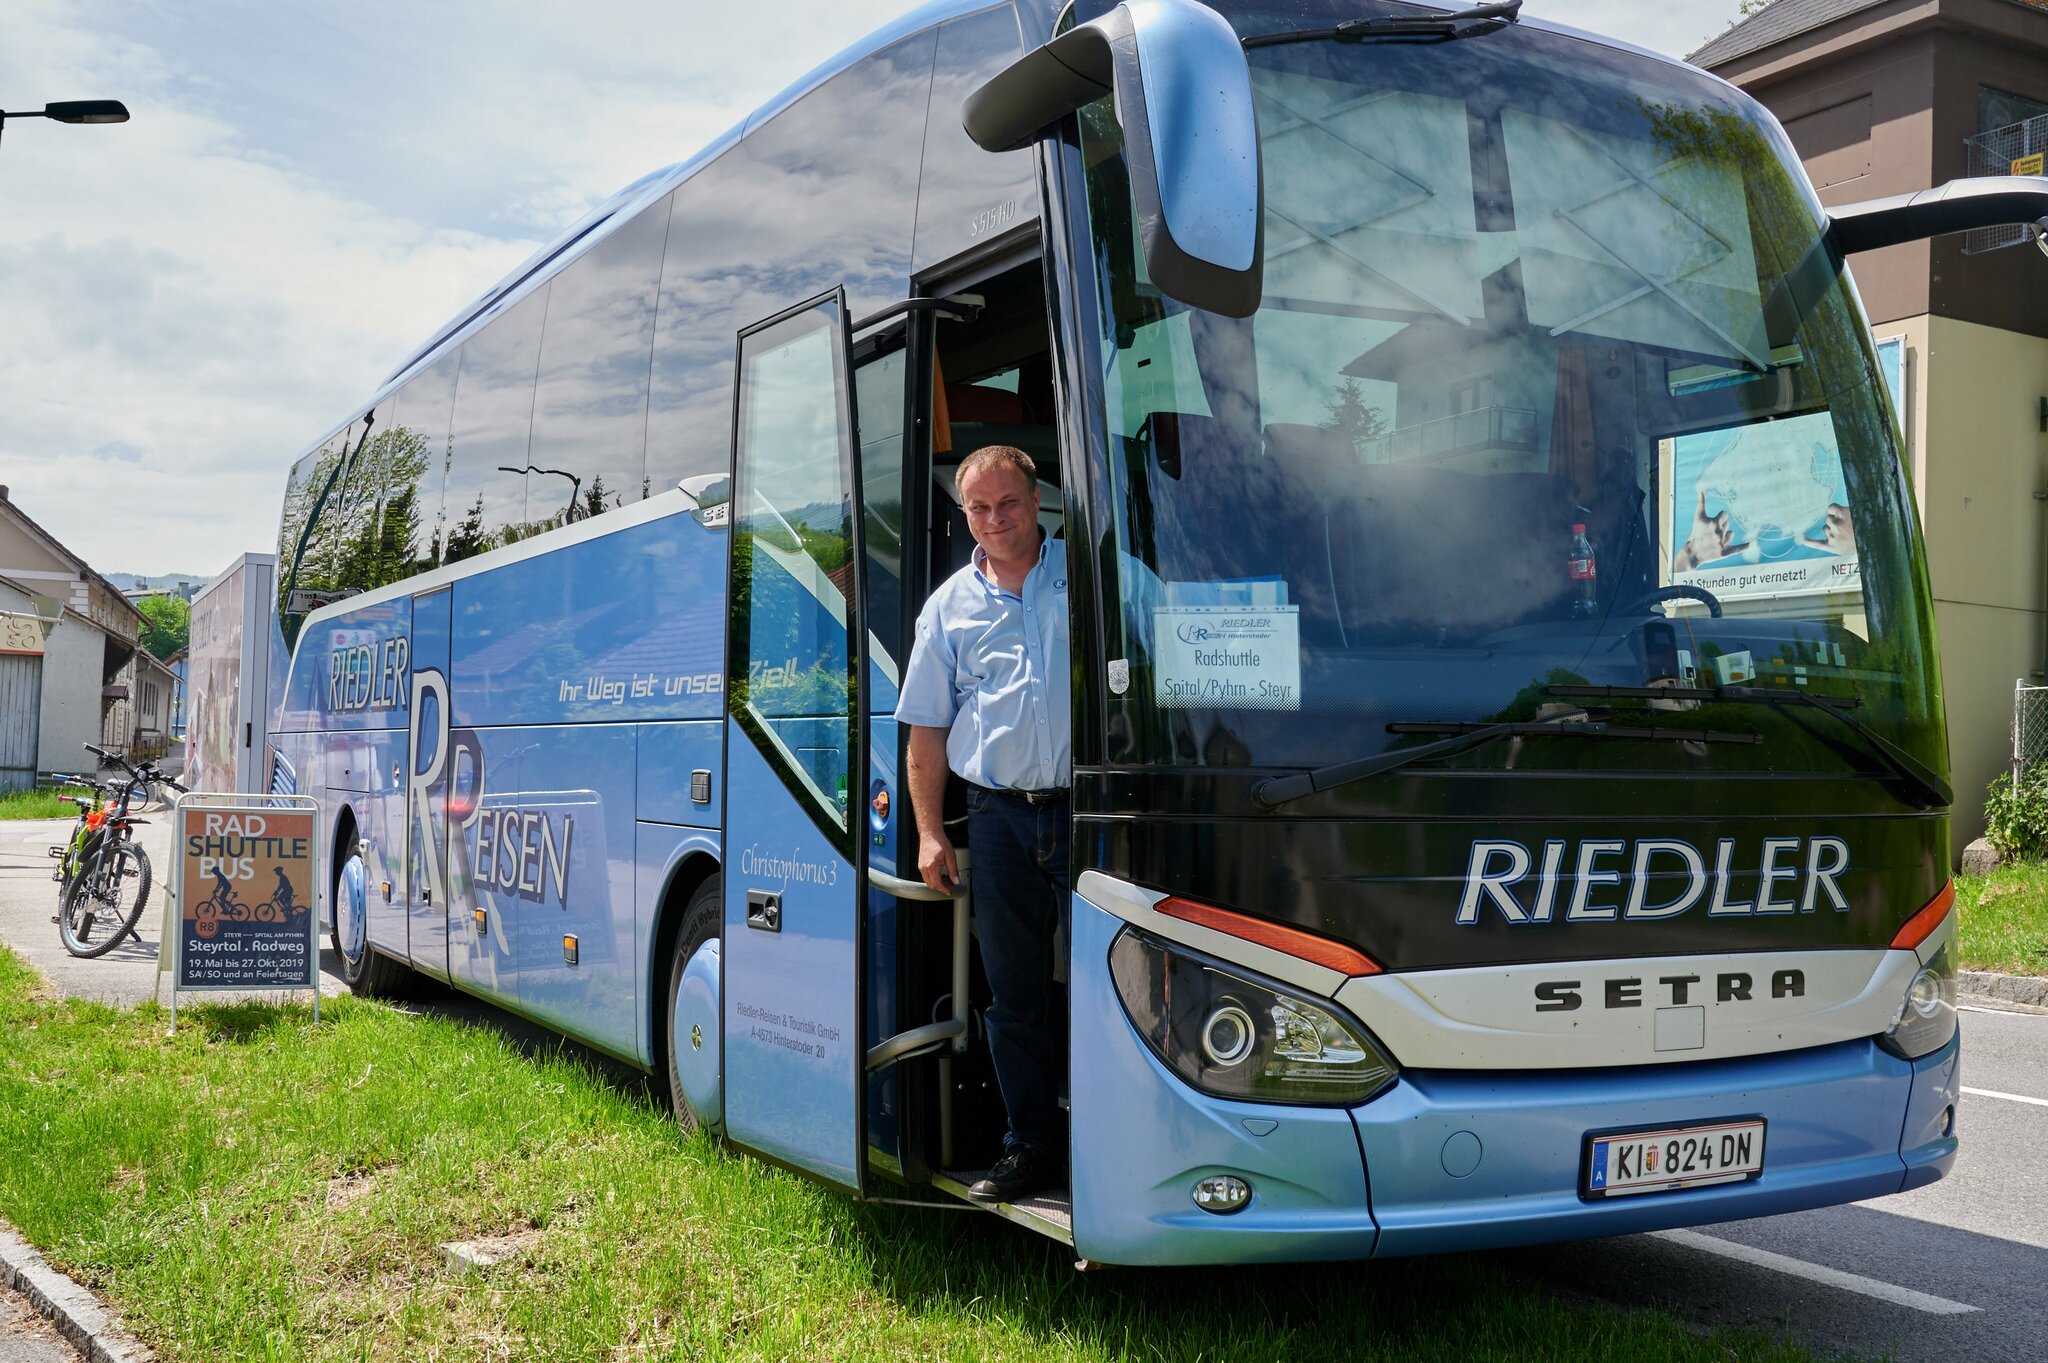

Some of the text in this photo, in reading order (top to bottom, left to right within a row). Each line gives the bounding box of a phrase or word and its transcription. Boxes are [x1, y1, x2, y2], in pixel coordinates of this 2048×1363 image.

[971, 200, 1016, 237] S 515 HD
[1696, 575, 1736, 590] Stunden
[1739, 574, 1757, 589] gut
[1760, 569, 1807, 585] vernetzt!
[1221, 618, 1271, 628] RIEDLER
[1195, 649, 1260, 667] Radshuttle
[327, 635, 409, 713] RIEDLER
[559, 680, 583, 702] Ihr
[586, 677, 626, 705] Weg
[630, 673, 659, 698] ist
[1259, 680, 1291, 700] Steyr
[206, 813, 266, 837] RAD
[188, 835, 308, 859] SHUTTLE
[200, 857, 255, 880] BUS
[741, 843, 837, 893] Christophorus 3
[1455, 836, 1850, 924] RIEDLER
[200, 922, 215, 931] R8
[189, 940, 241, 954] Steyrtal
[252, 940, 304, 954] Radweg
[189, 959, 304, 968] 19. Mai bis 27. Okt. 2019
[223, 970, 240, 978] und
[256, 970, 304, 980] Feiertagen
[1534, 969, 1806, 1012] SETRA
[737, 1001, 840, 1042] Riedler-Reisen & Touristik GmbH
[751, 1025, 825, 1058] A-4573 Hinterstoder 20
[1595, 1132, 1752, 1181] A KI 824 DN
